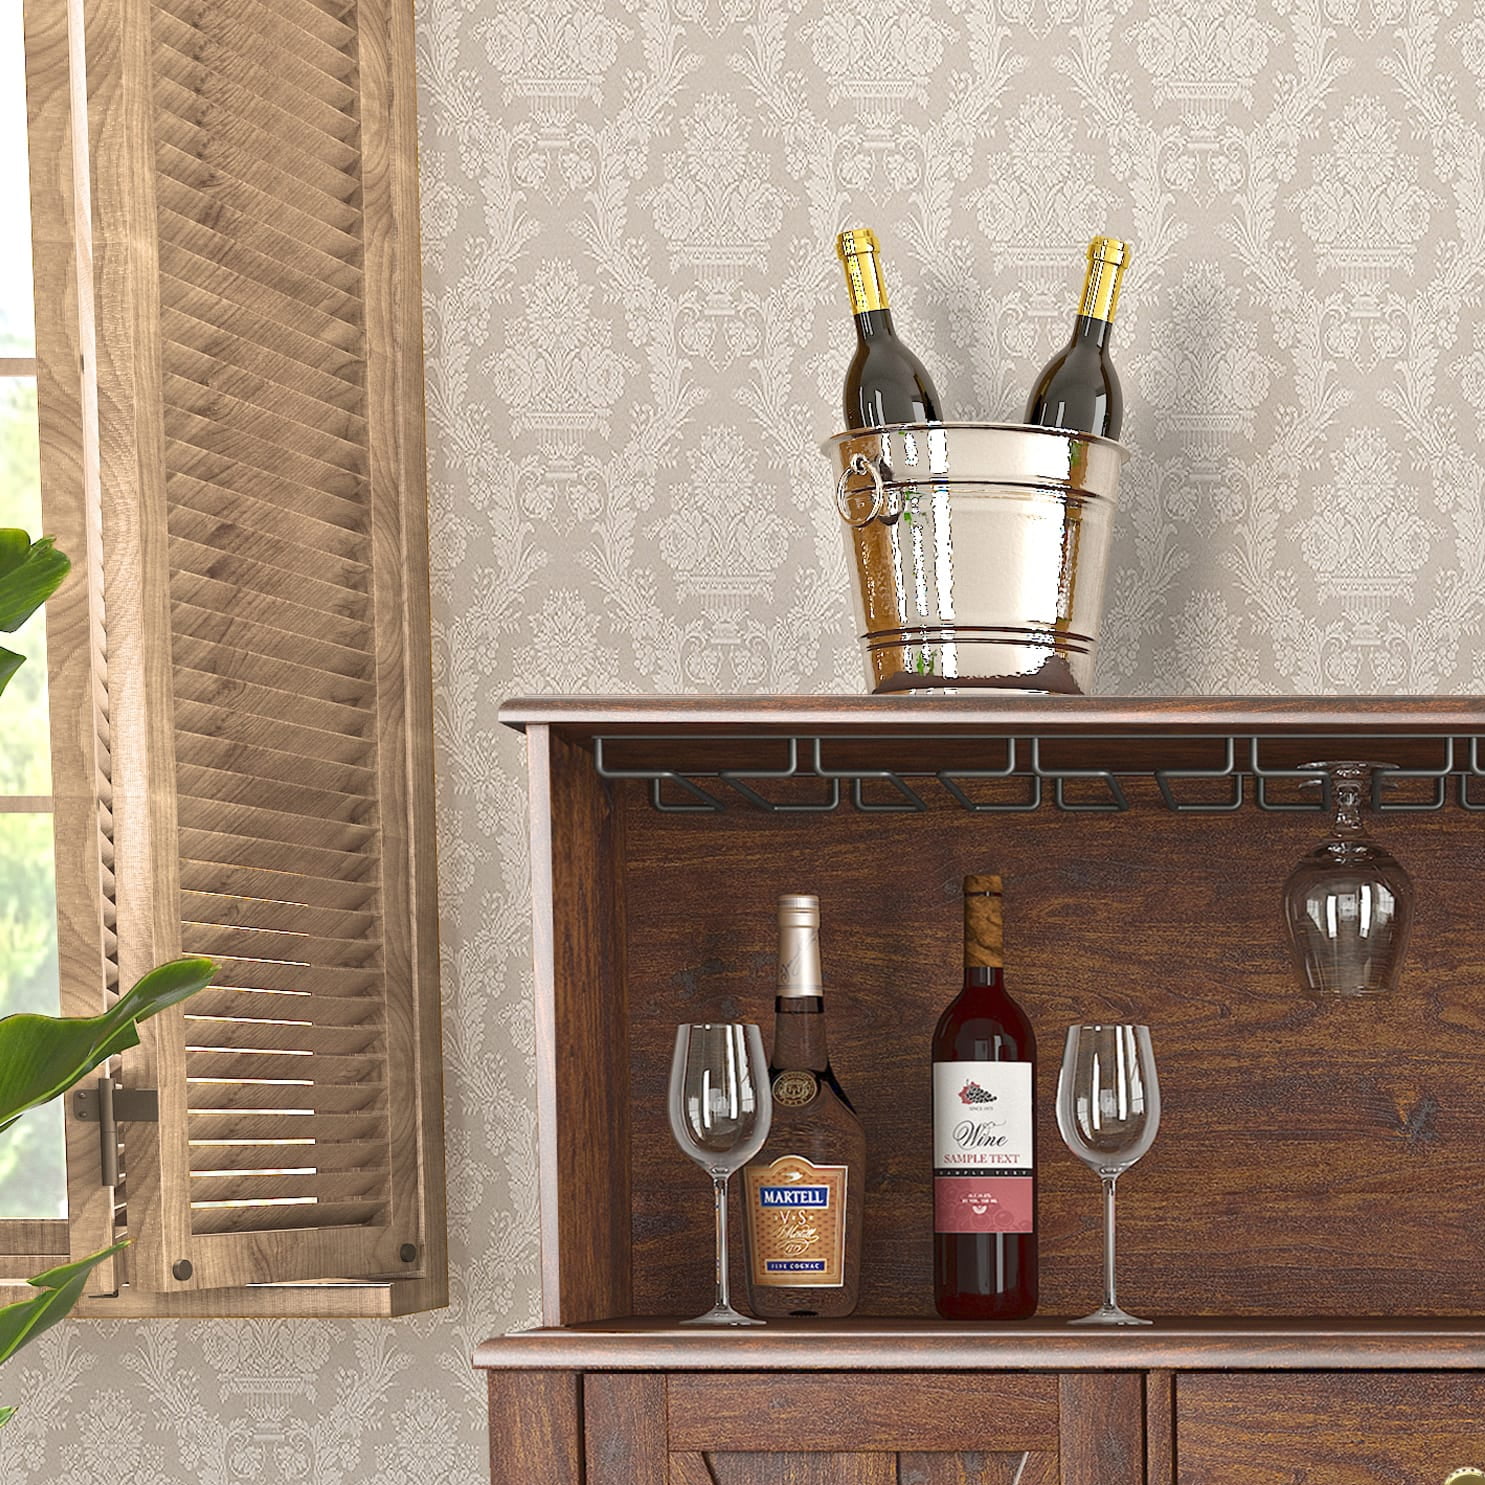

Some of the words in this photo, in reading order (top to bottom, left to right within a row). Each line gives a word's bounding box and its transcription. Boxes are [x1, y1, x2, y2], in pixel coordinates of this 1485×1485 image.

[952, 1120, 1009, 1151] Wine
[943, 1154, 988, 1164] SAMPLE
[989, 1154, 1020, 1164] TEXT
[764, 1190, 824, 1204] MARTELL
[790, 1262, 820, 1270] COGNAC
